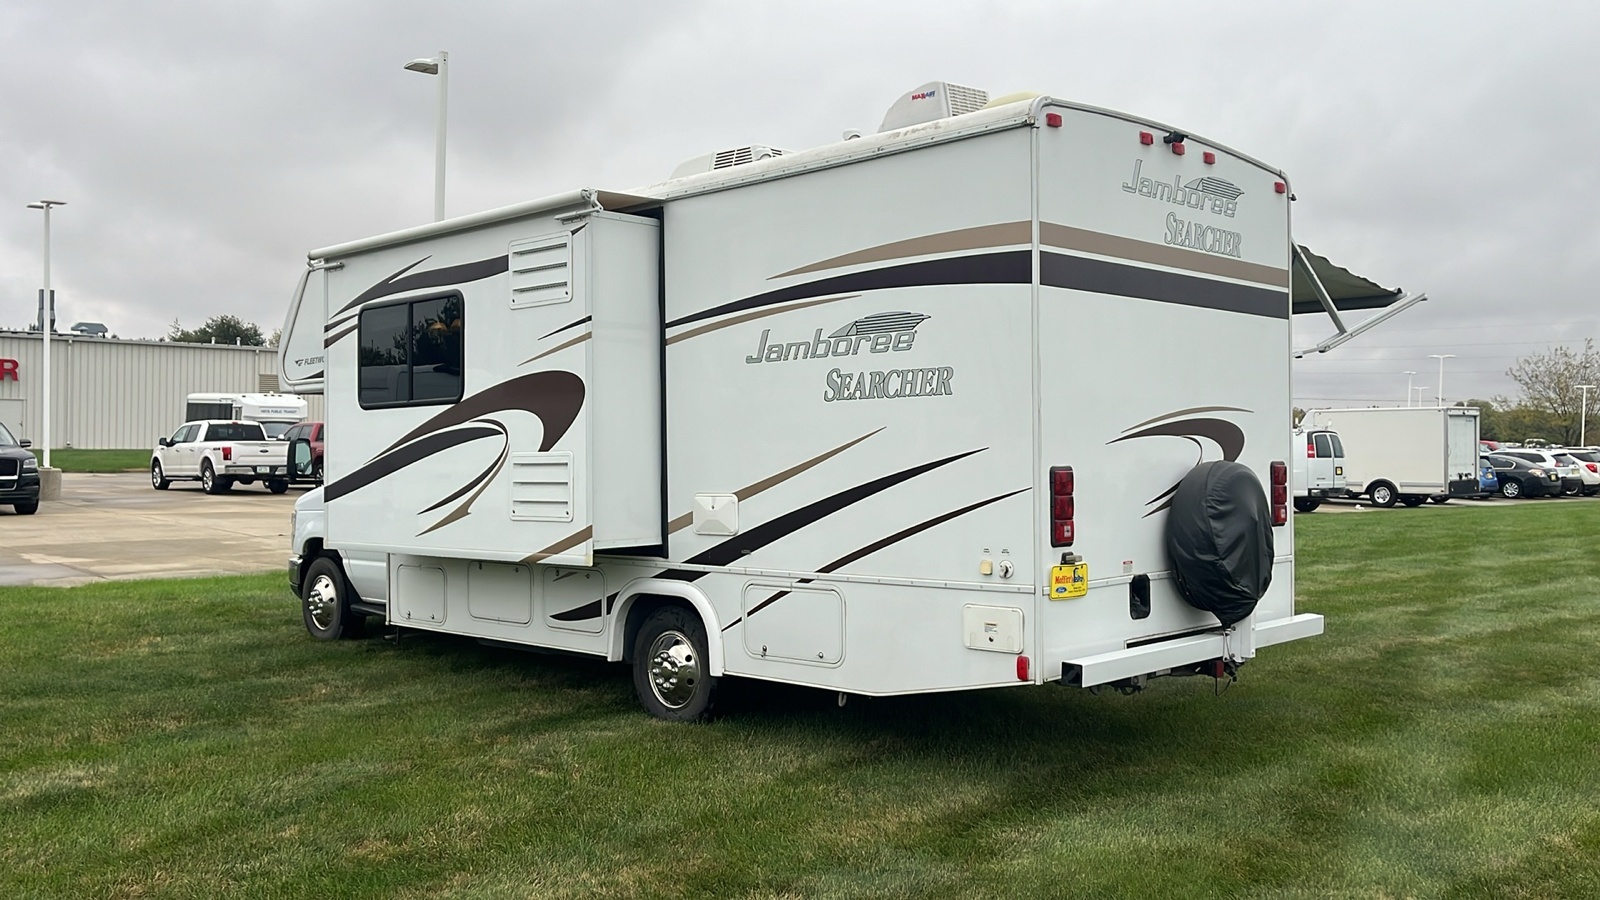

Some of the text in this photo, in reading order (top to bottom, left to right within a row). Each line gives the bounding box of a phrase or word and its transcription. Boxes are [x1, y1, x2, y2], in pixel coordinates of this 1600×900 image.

[1122, 158, 1237, 218] Jamboree
[1164, 211, 1241, 258] SEARCHER
[745, 328, 916, 364] Jamboree
[0, 358, 19, 381] R
[823, 366, 954, 403] SEARCHER
